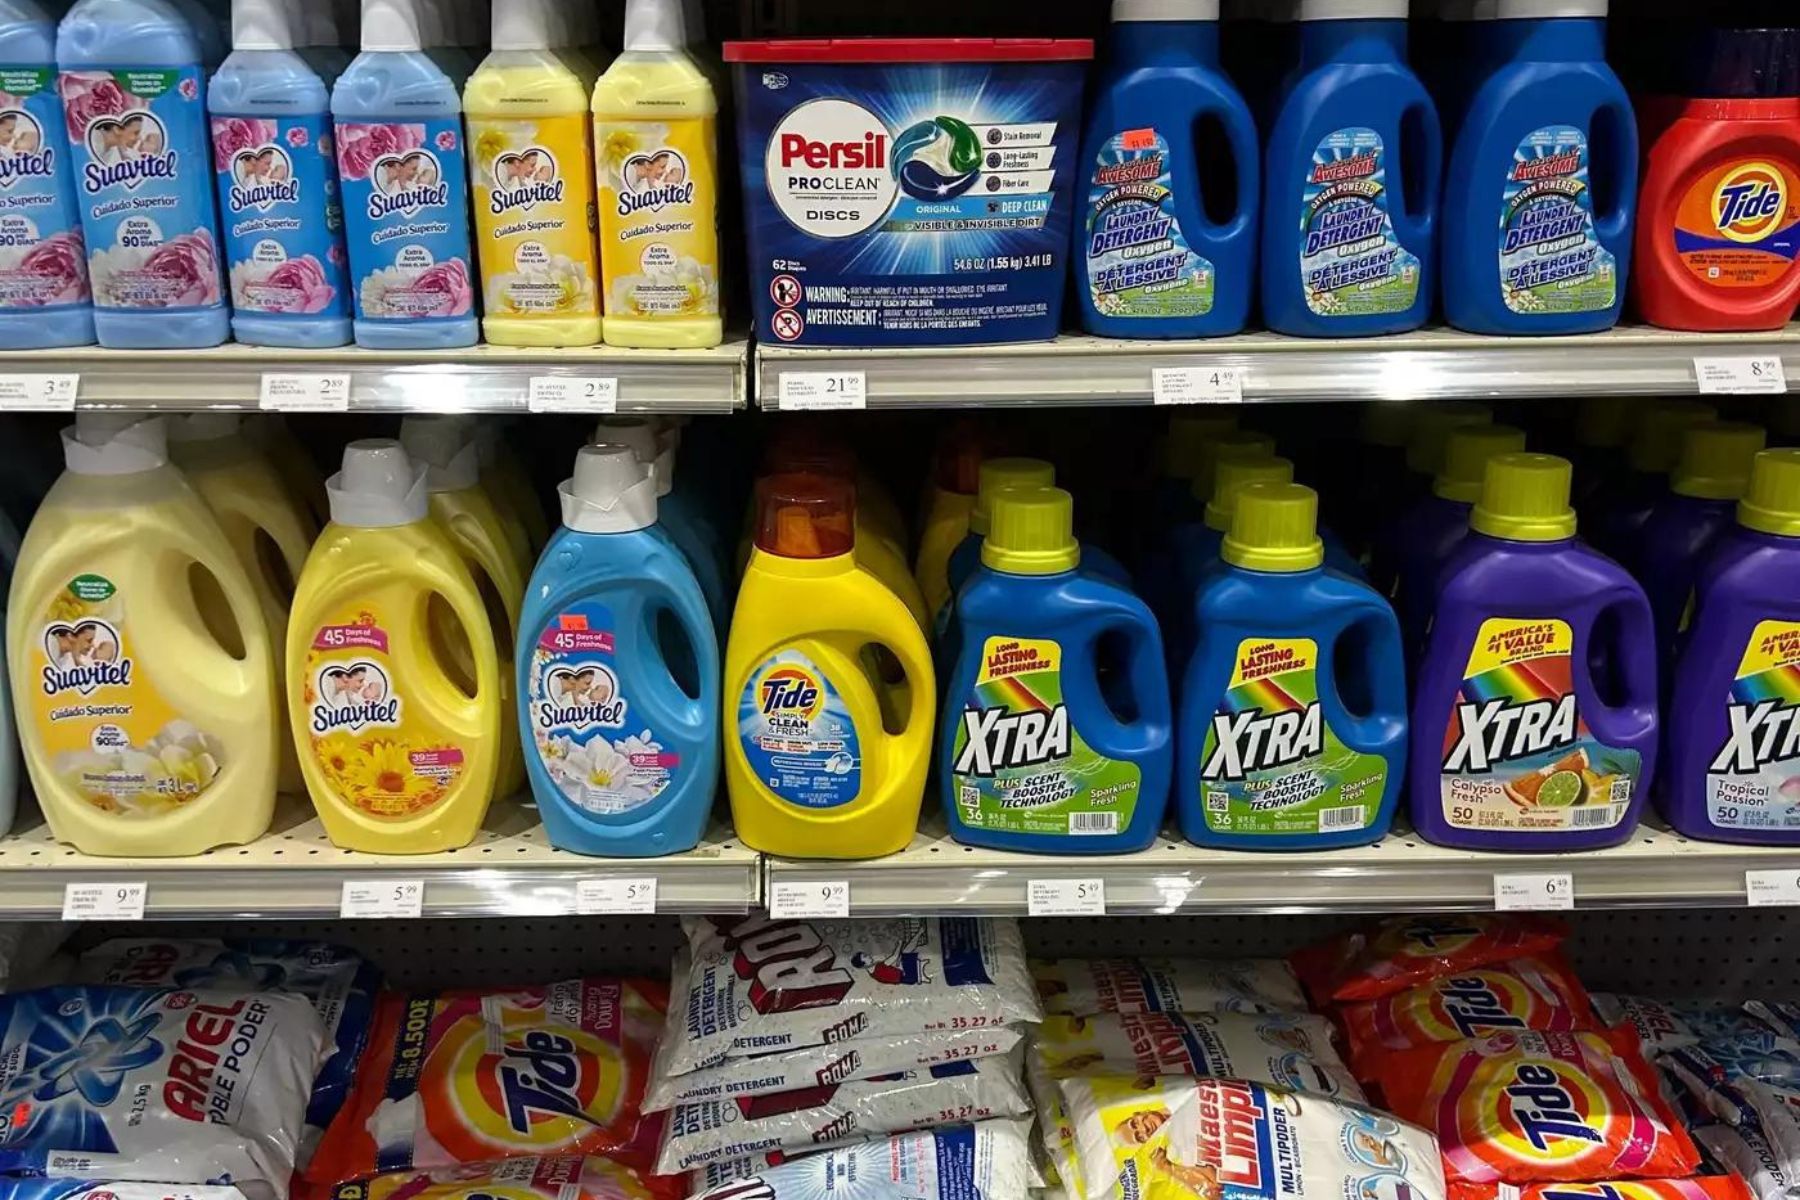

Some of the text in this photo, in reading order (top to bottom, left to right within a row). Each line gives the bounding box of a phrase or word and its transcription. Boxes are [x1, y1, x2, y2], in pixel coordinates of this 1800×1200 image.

[781, 131, 885, 169] Persil
[85, 152, 176, 192] Suavitel
[1096, 162, 1161, 185] AWESOME
[1313, 160, 1375, 183] AWESOME
[1513, 157, 1579, 180] AWESOME
[788, 177, 879, 190] PROCLEAN
[1121, 184, 1161, 199] POWERED
[231, 180, 298, 211] Suavitel
[370, 183, 447, 218] Suavitel
[491, 180, 563, 213] Suavitel
[618, 182, 693, 215] Suavitel
[1311, 182, 1375, 209] OXYGEN POWERED
[1511, 180, 1578, 207] OXYGEN POWERED
[93, 196, 176, 218] Cuidado Superior
[916, 205, 961, 214] ORIGINAL
[1002, 200, 1048, 213] DEEP CLEAN
[1522, 203, 1573, 226] LAUNDRY
[1718, 182, 1781, 229] Tide
[806, 210, 860, 221] DISCS
[914, 221, 955, 230] VISIBLE
[965, 220, 1015, 228] INVISIBLE
[1017, 218, 1040, 227] DIRT
[1107, 208, 1158, 230] LAUNDRY
[1322, 206, 1372, 229] LAUNDRY
[373, 223, 447, 243] Cuidado Superior
[494, 220, 563, 238] Cuidado Superior
[620, 222, 692, 240] Cuidado Superior
[1092, 220, 1171, 254] DETERGENT
[1308, 217, 1383, 252] DETERGENT
[1507, 215, 1584, 251] DETERGENT
[122, 236, 139, 247] 90
[772, 260, 786, 270] 62
[954, 259, 972, 270] 54.6
[974, 259, 985, 270] OZ
[1024, 255, 1039, 267] 3.41
[1042, 254, 1051, 266] LB
[1096, 255, 1185, 282] DÉTERGENT
[1311, 252, 1396, 280] DÉTERGENT
[1509, 250, 1595, 279] DÉTERGENT
[1117, 267, 1176, 288] LESSIVE
[1332, 265, 1387, 286] LESSIVE
[1529, 263, 1587, 284] LESSIVE
[805, 286, 850, 303] WARNING:
[1751, 362, 1762, 376] 8
[44, 380, 55, 395] 3
[320, 380, 331, 393] 2
[826, 378, 844, 392] 21
[1210, 372, 1219, 386] 4
[585, 383, 595, 396] 2
[324, 629, 362, 645] 45 Days
[554, 633, 593, 648] 45 Days
[1488, 624, 1553, 645] AMERICA'S
[1505, 633, 1555, 650] VALUE
[996, 642, 1019, 652] LONG
[1250, 643, 1275, 655] LONG
[1509, 645, 1544, 656] BRAND
[988, 648, 1038, 667] LASTING
[1241, 648, 1294, 669] LASTING
[43, 660, 131, 695] Suavitel
[989, 660, 1051, 677] FRESHNESS
[1241, 659, 1306, 680] FRESHNESS
[763, 679, 818, 714] Tide
[51, 705, 131, 720] Cuidado Superior
[314, 699, 397, 732] Suavitel
[540, 701, 623, 728] Suavitel
[768, 719, 809, 728] CLEAN
[776, 728, 809, 736] FRESH
[1443, 694, 1577, 771] XTRA
[96, 737, 110, 747] 90
[954, 704, 1071, 775] XTRA
[1201, 702, 1322, 779] XTRA
[412, 753, 425, 762] 39
[632, 755, 645, 763] 39
[993, 772, 1061, 789] PLUS SCENT
[1012, 780, 1066, 799] BOOSTER
[1090, 781, 1137, 798] Sparkling
[1243, 770, 1313, 792] PLUS SCENT
[1263, 779, 1317, 800] BOOSTER
[1340, 773, 1383, 793] Sparkling
[1451, 779, 1501, 795] Calypso
[1717, 779, 1769, 797] Tropical
[1000, 787, 1077, 809] TECHNOLOGY
[1090, 795, 1118, 807] Fresh
[1250, 785, 1327, 810] TECHNOLOGY
[1339, 788, 1365, 802] Fresh
[1451, 789, 1483, 803] Fresh
[1716, 790, 1765, 807] Passion
[966, 808, 983, 820] 36
[1214, 813, 1232, 825] 36
[1453, 807, 1473, 819] 50
[1717, 806, 1738, 819] 50
[393, 886, 403, 901] 5
[627, 884, 636, 899] 5
[822, 886, 832, 902] 9
[1078, 883, 1086, 898] 5
[1546, 879, 1556, 894] 6
[117, 888, 127, 904] 9
[702, 966, 716, 1036] DETERGENT
[1439, 976, 1528, 1038] Tide
[688, 985, 702, 1041] LAUNDRY
[821, 1011, 869, 1045] ROMA
[951, 1016, 987, 1029] 35.27
[223, 1000, 271, 1073] PODER
[733, 1033, 792, 1048] DETERGENT
[163, 996, 248, 1122] ARIEL
[944, 1044, 998, 1060] 35.27 oz
[816, 1049, 861, 1086] ROMA
[502, 1030, 604, 1135] Tide
[726, 1076, 785, 1092] DETERGENT
[939, 1105, 991, 1121] 35.27 oz
[1505, 1064, 1605, 1150] Tide
[679, 1138, 782, 1169] LAUNDRY DETERGENT
[1274, 1107, 1296, 1194] MULTIPODER
